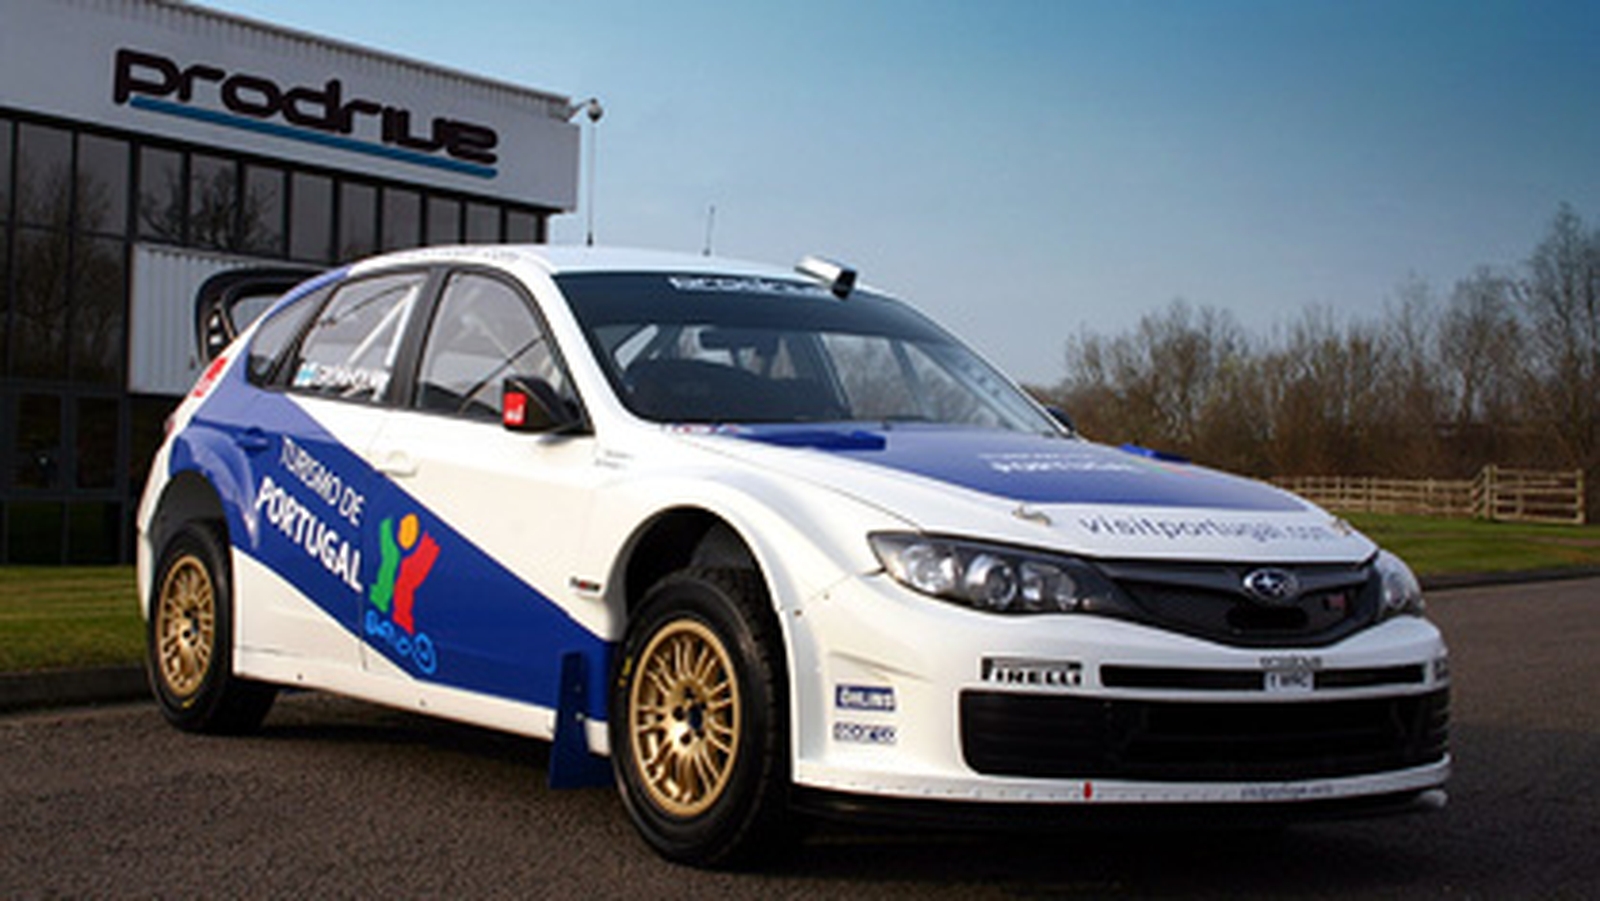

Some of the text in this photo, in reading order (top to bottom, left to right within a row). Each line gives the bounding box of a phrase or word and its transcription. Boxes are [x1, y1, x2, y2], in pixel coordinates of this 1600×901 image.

[113, 48, 499, 165] prodrive
[280, 434, 366, 527] TURISMO DE
[254, 475, 364, 593] PORTUGAL
[980, 656, 1083, 686] PIRELLI
